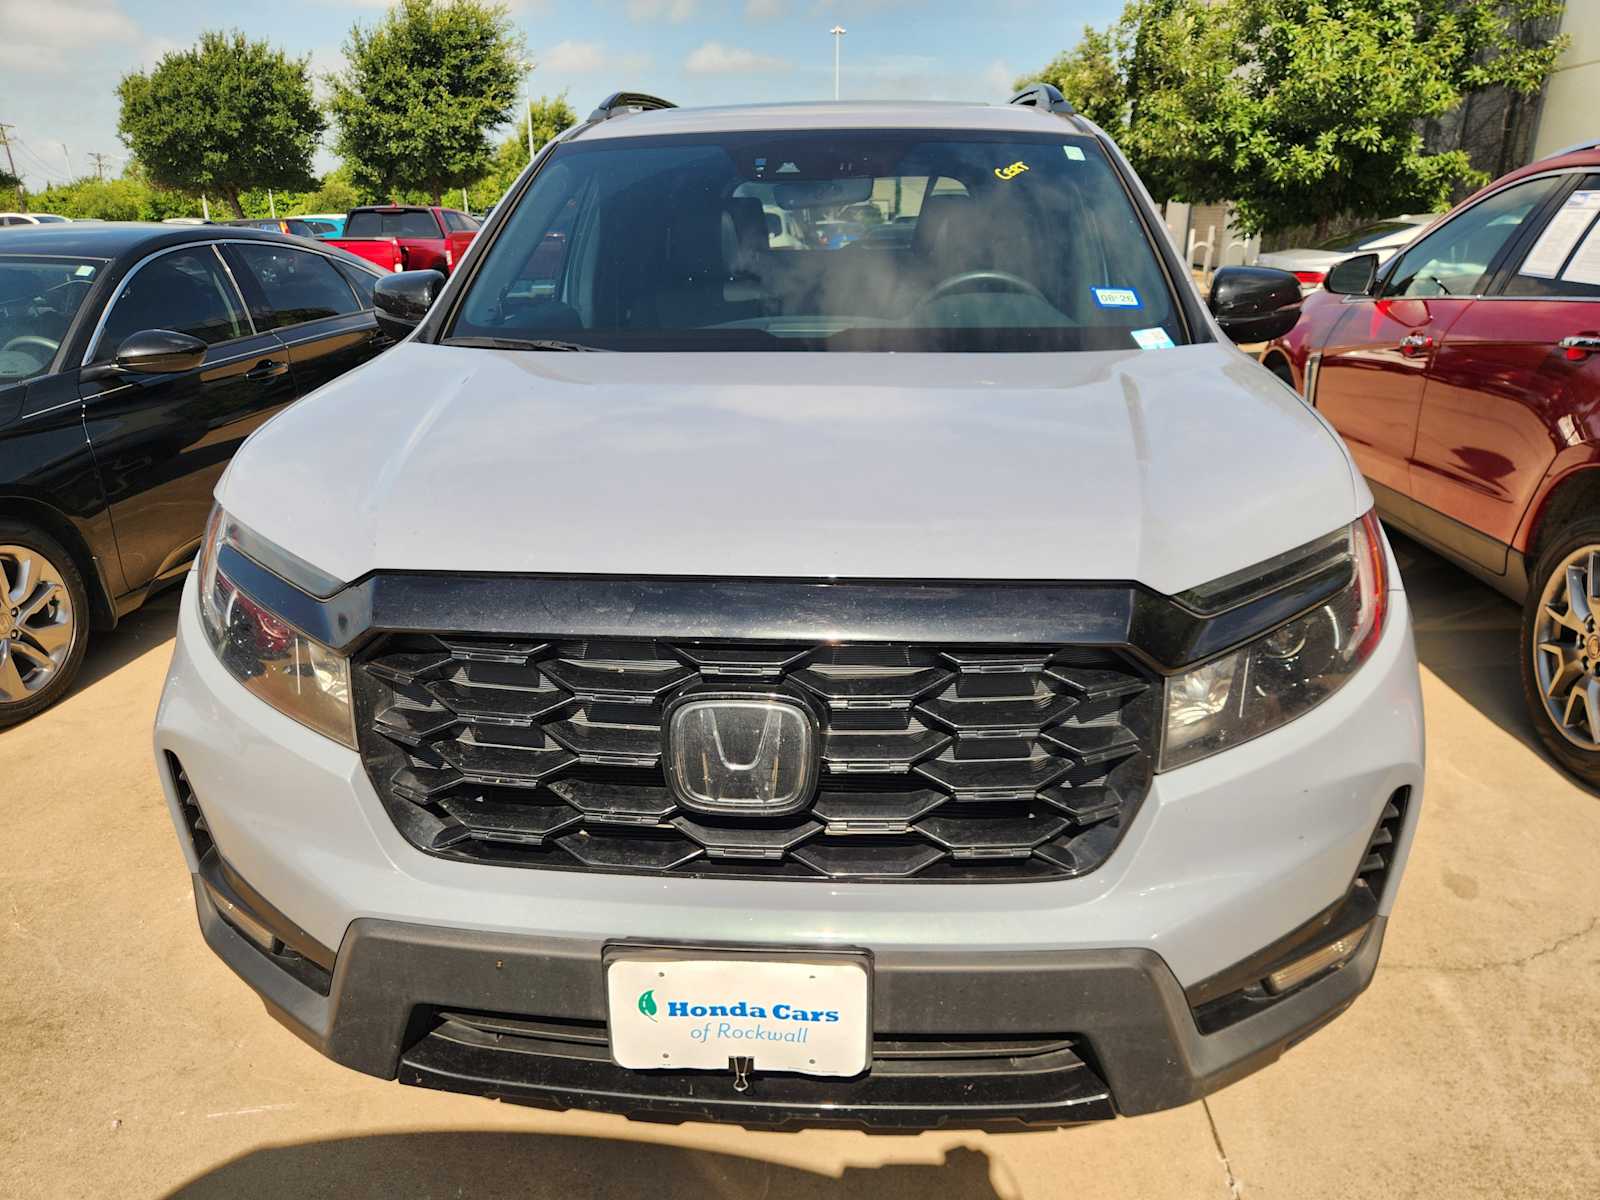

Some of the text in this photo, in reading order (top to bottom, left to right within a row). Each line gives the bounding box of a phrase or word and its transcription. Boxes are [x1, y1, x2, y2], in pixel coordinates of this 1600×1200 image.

[667, 1001, 840, 1022] Honda Cars
[690, 1022, 809, 1044] of Rockwall
